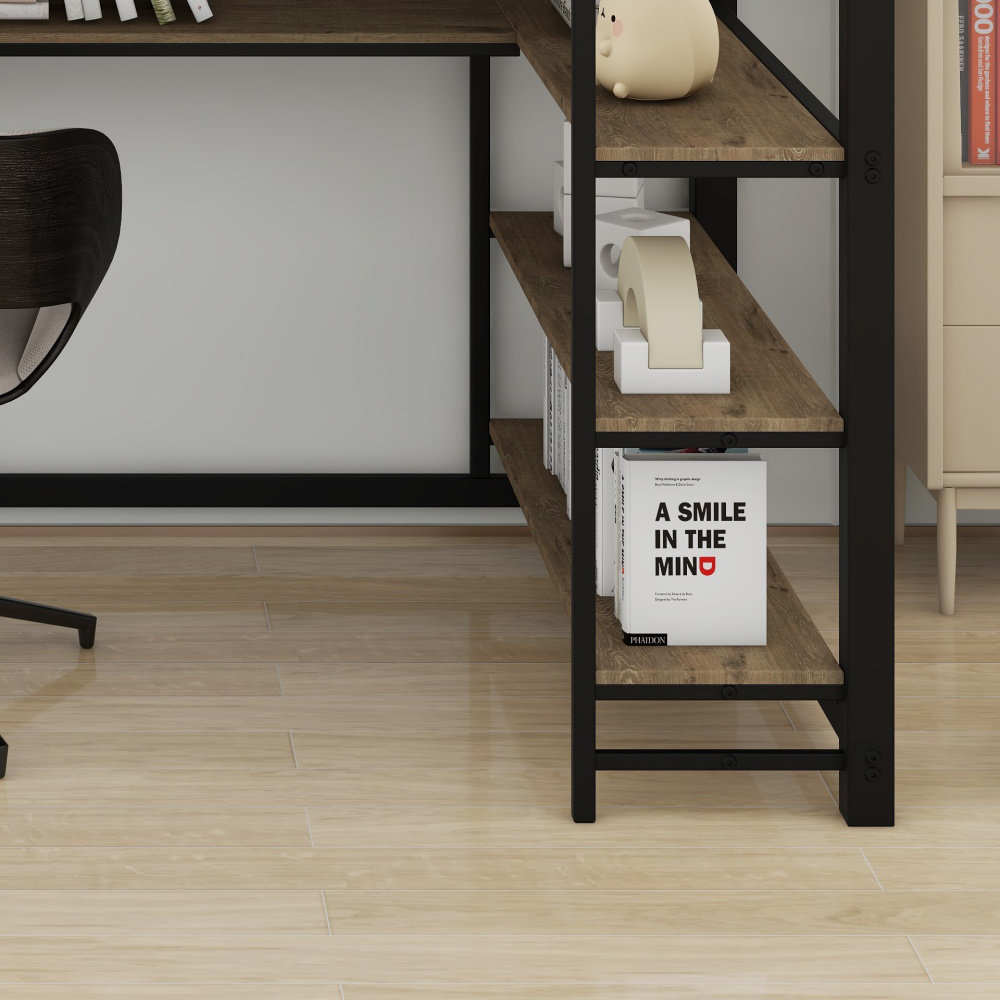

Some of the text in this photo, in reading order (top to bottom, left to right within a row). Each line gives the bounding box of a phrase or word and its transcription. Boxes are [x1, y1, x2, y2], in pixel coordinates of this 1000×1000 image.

[655, 502, 746, 522] A SMILE
[655, 529, 726, 549] IN THE
[655, 556, 716, 576] MIND
[630, 636, 666, 645] PHAIDON
